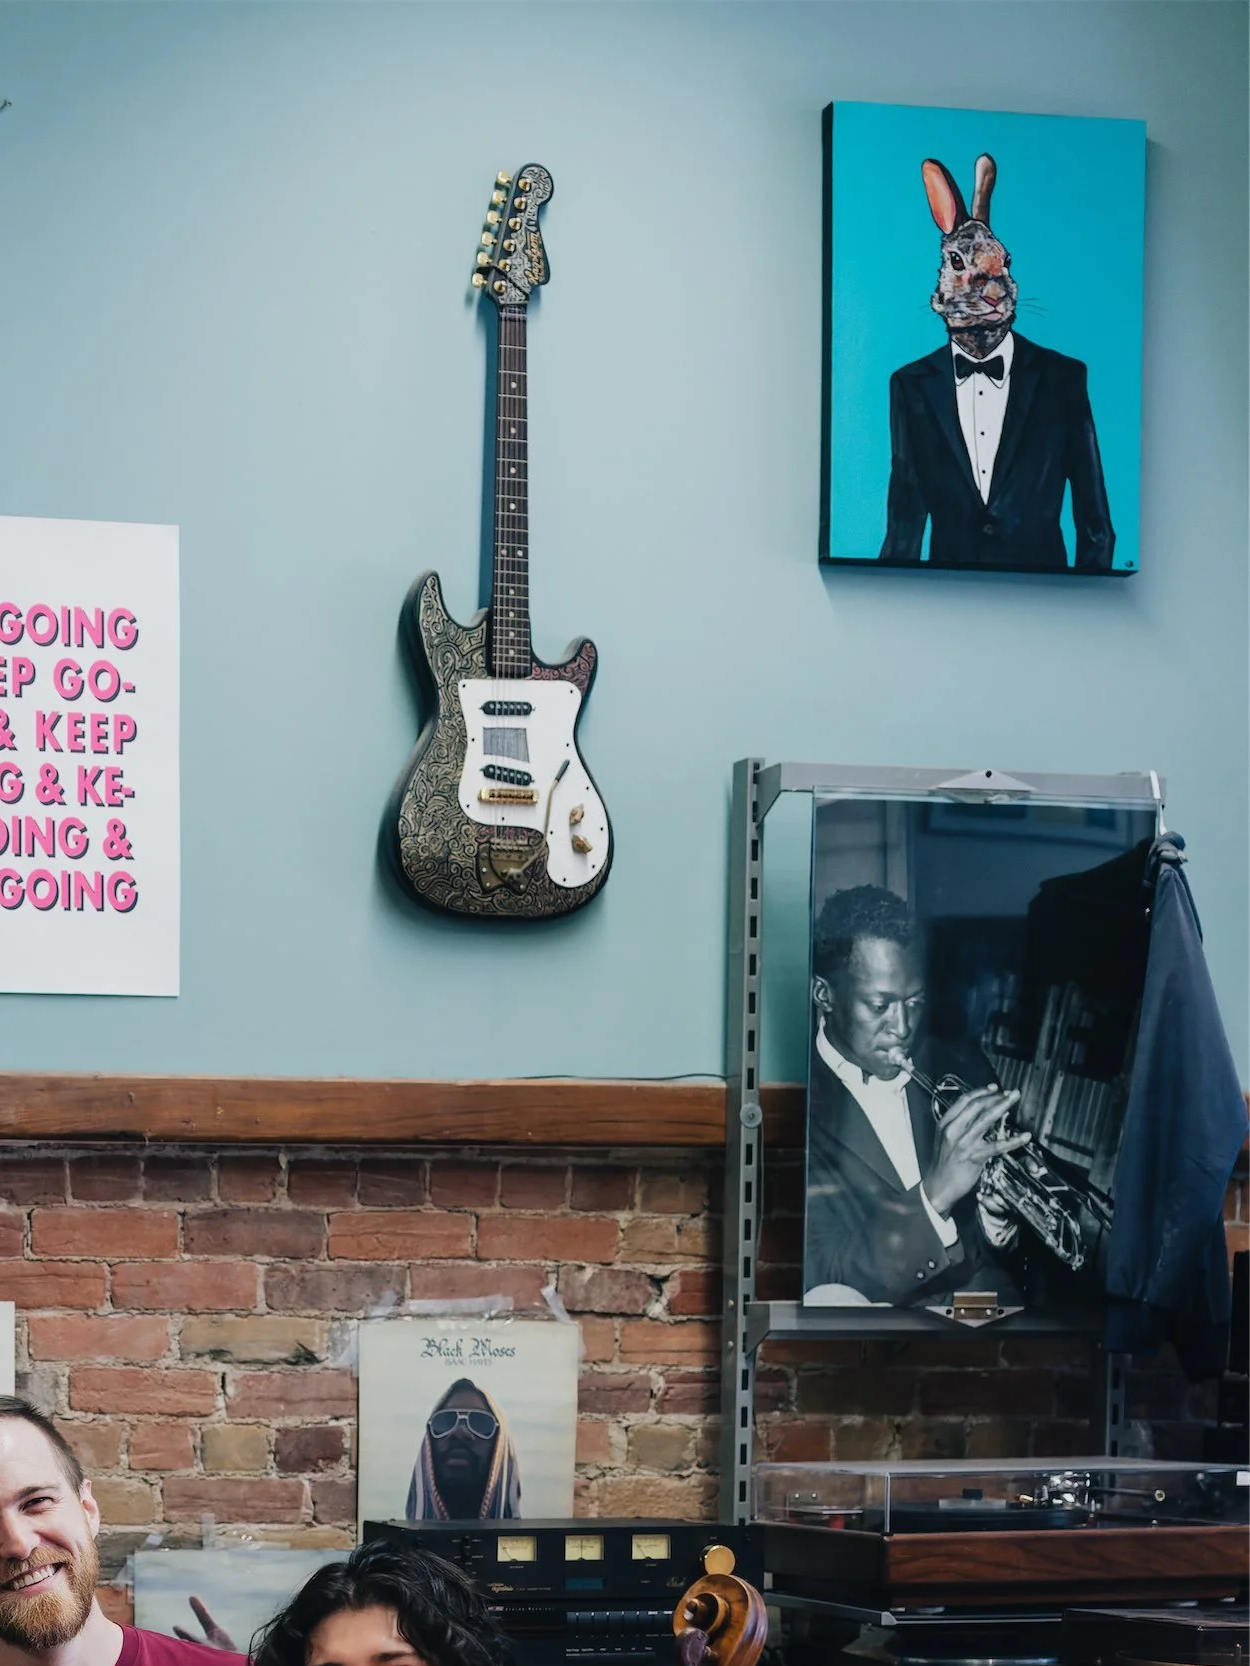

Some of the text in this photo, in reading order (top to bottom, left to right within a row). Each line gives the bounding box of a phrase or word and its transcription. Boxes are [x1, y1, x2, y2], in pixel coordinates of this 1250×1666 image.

[53, 658, 136, 703] GO-
[35, 711, 137, 754] KEEP
[35, 763, 66, 806] &
[77, 766, 135, 807] KE-
[102, 818, 134, 860] &
[421, 1337, 516, 1358] Black Moses
